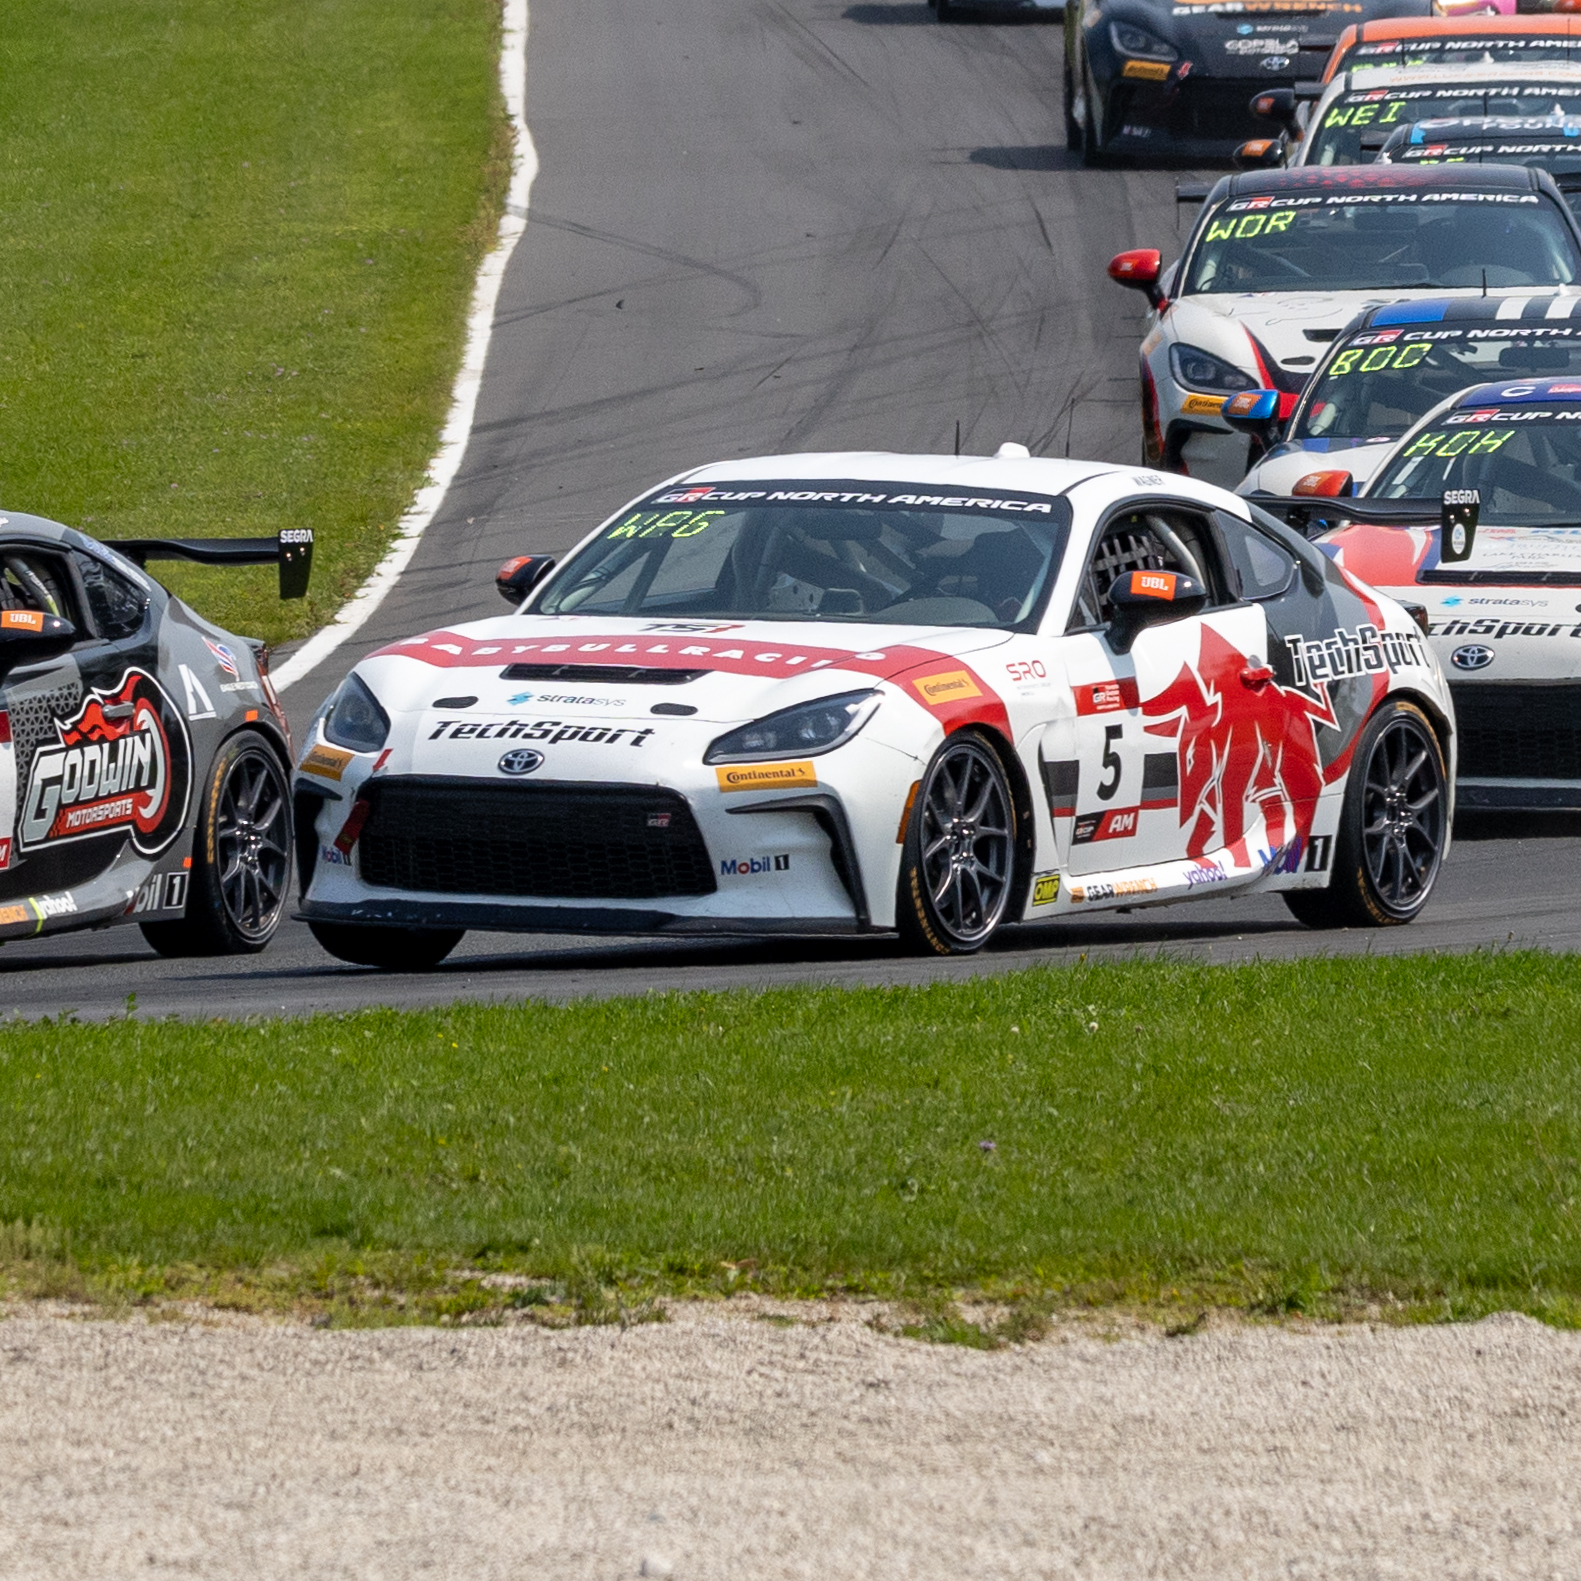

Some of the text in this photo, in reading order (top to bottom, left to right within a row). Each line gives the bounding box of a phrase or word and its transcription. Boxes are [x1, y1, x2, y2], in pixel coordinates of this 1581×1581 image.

[1172, 1, 1364, 18] GEARWRENCH
[1396, 42, 1440, 54] CUP
[1444, 40, 1527, 51] NORTH
[1384, 89, 1431, 101] CUP
[1434, 87, 1519, 100] NORTH
[1323, 101, 1407, 129] WEI
[1443, 145, 1494, 157] CUP
[1268, 196, 1321, 209] CUP
[1326, 193, 1417, 205] NORTH
[1421, 192, 1539, 204] AMERICA
[1205, 209, 1297, 242] WOR
[1402, 329, 1456, 341] CUP
[1465, 326, 1571, 340] NORTH
[1488, 411, 1552, 422] CUP
[701, 490, 767, 501] CUP
[768, 490, 886, 505] NORTH
[887, 493, 1053, 514] AMERICA
[1443, 489, 1481, 506] SEGRA
[279, 528, 314, 545] SEGRA
[1467, 596, 1550, 608] stratasys
[1284, 623, 1431, 687] TechSport
[1005, 659, 1048, 682] SRO
[536, 692, 627, 709] stratasys
[427, 718, 658, 750] TechSport
[1096, 723, 1124, 801] 5
[22, 731, 152, 844] GODWIN
[725, 768, 796, 786] Continental
[64, 797, 134, 829] MOTORSPORTS
[1107, 812, 1134, 835] AM
[720, 854, 771, 877] Mobil
[1183, 857, 1230, 891] yahoo!
[37, 890, 79, 920] yahoo!
